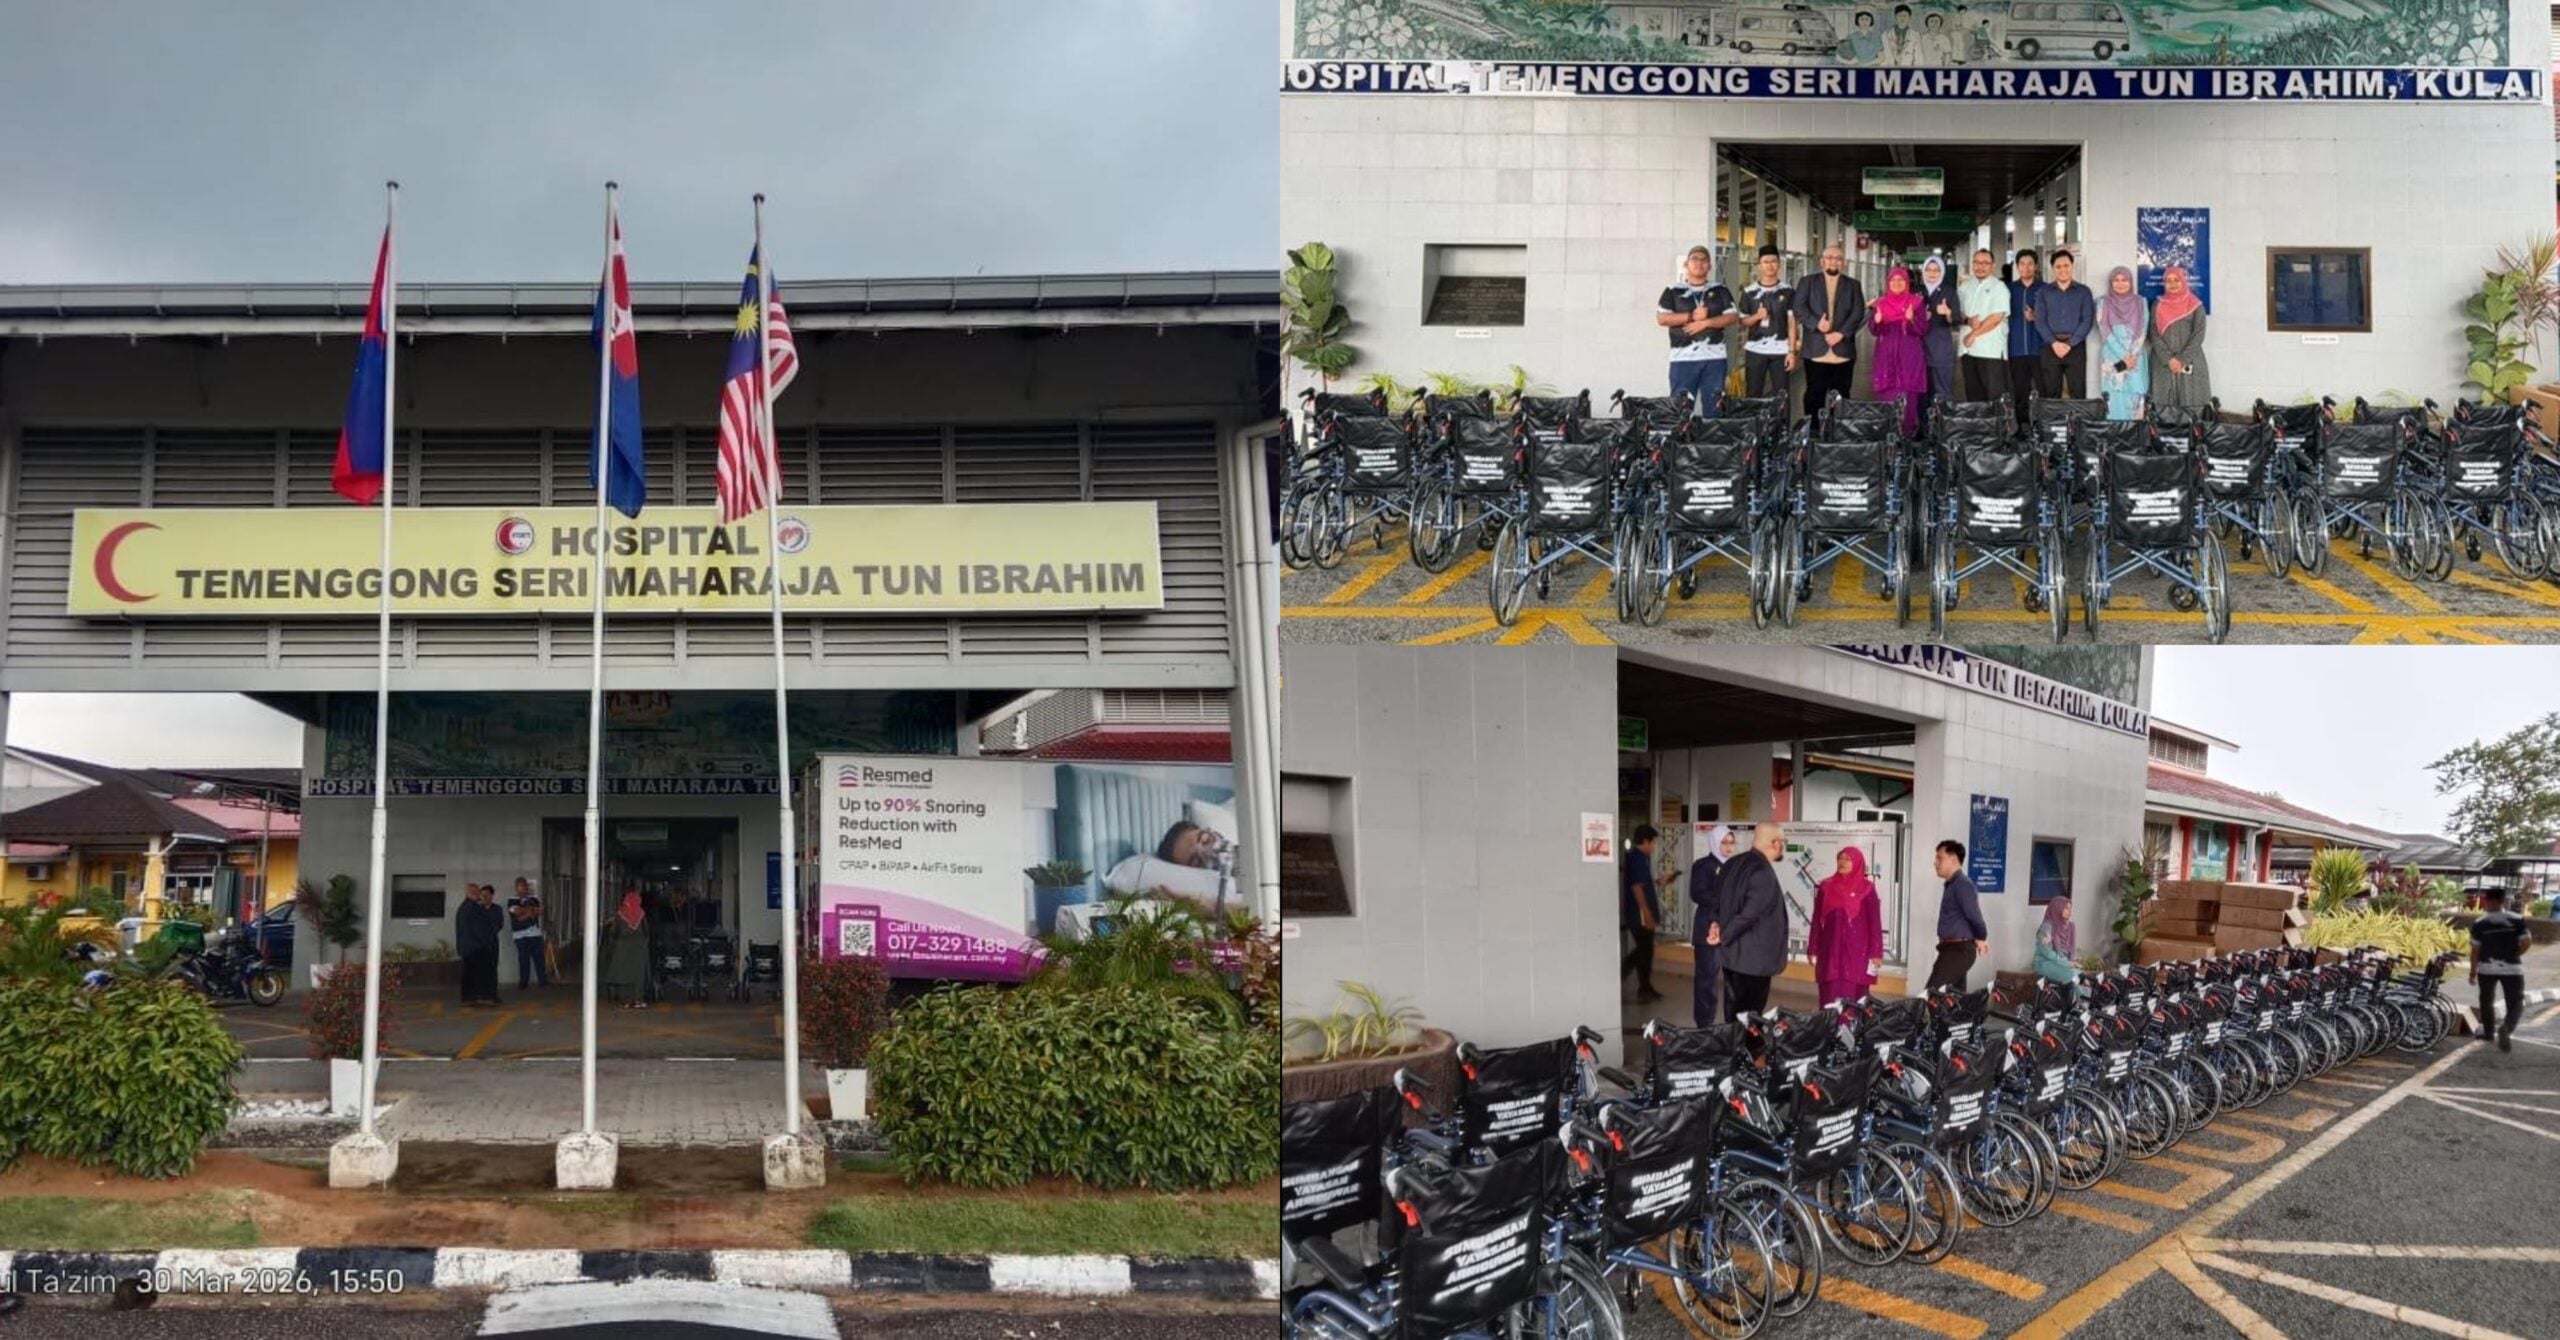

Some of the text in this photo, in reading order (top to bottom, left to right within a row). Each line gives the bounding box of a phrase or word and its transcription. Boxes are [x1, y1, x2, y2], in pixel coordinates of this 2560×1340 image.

[1280, 63, 2540, 99] OSPITAL TEMENGGONG SERI MAHARAJA TUN IBRAHIM, KULAI
[552, 526, 760, 556] HOSPITAL
[176, 563, 1145, 599] TEMENGGONG SERI MAHARAJA TUN IBRAHIM
[1965, 657, 2008, 693] TUN
[863, 766, 933, 782] Resmed
[309, 778, 409, 794] HOSPIAL
[421, 778, 562, 794] TEMENGGONG
[571, 779, 618, 794] SRI
[627, 778, 746, 793] MAHARAJA
[839, 797, 986, 817] Up to 90% Snoring
[839, 816, 957, 833] Reduction with
[839, 835, 902, 850] ResMed
[888, 922, 910, 933] Call
[888, 934, 1007, 953] 017-329 1488
